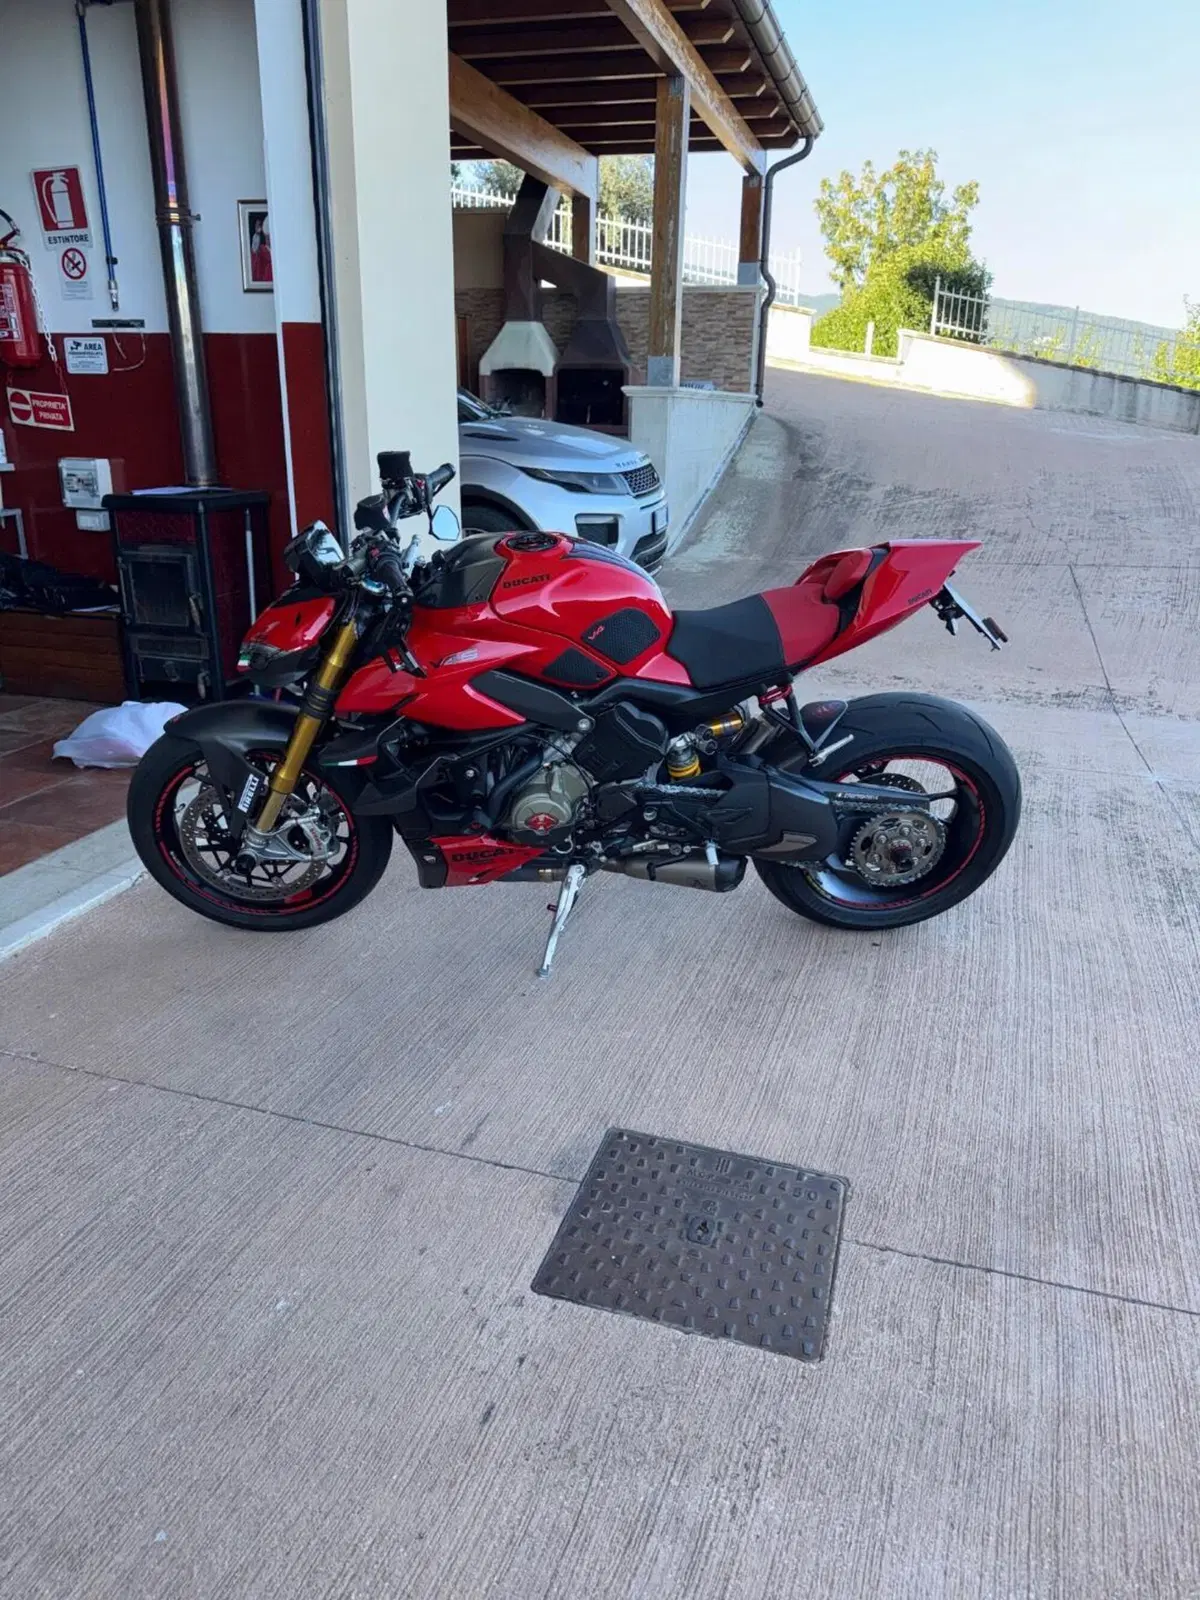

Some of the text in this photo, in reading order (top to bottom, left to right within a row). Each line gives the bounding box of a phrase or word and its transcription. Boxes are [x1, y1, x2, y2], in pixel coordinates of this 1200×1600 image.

[47, 234, 89, 244] ESTINTORE
[84, 342, 102, 350] AREA
[503, 574, 551, 588] DUCATI
[238, 774, 259, 813] PIRELLI
